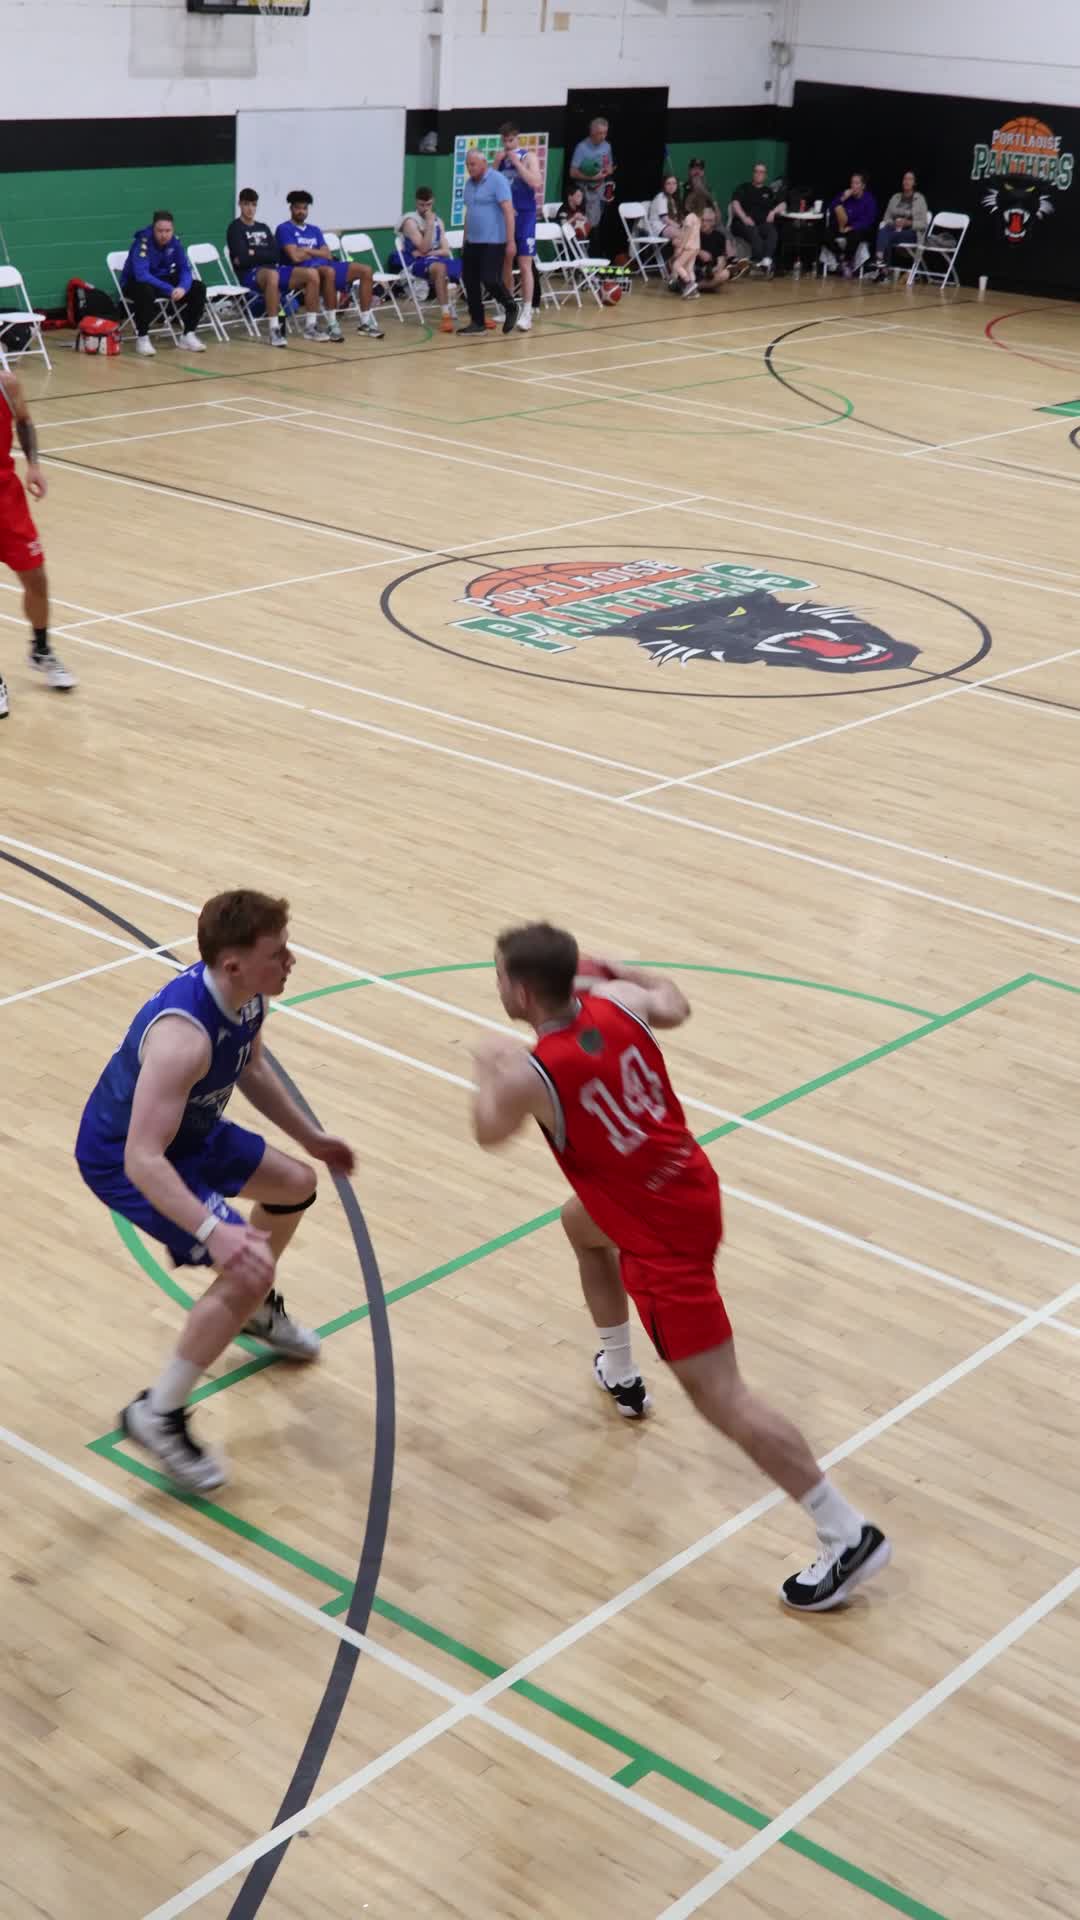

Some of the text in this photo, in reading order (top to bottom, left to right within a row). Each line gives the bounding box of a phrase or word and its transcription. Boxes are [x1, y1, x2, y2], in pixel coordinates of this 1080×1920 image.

[971, 144, 1074, 190] PANTHERS
[992, 130, 1062, 151] PORTLAOISE
[450, 562, 820, 653] PANTHERS
[461, 559, 683, 612] PORTLAOISE
[579, 1044, 667, 1157] 14
